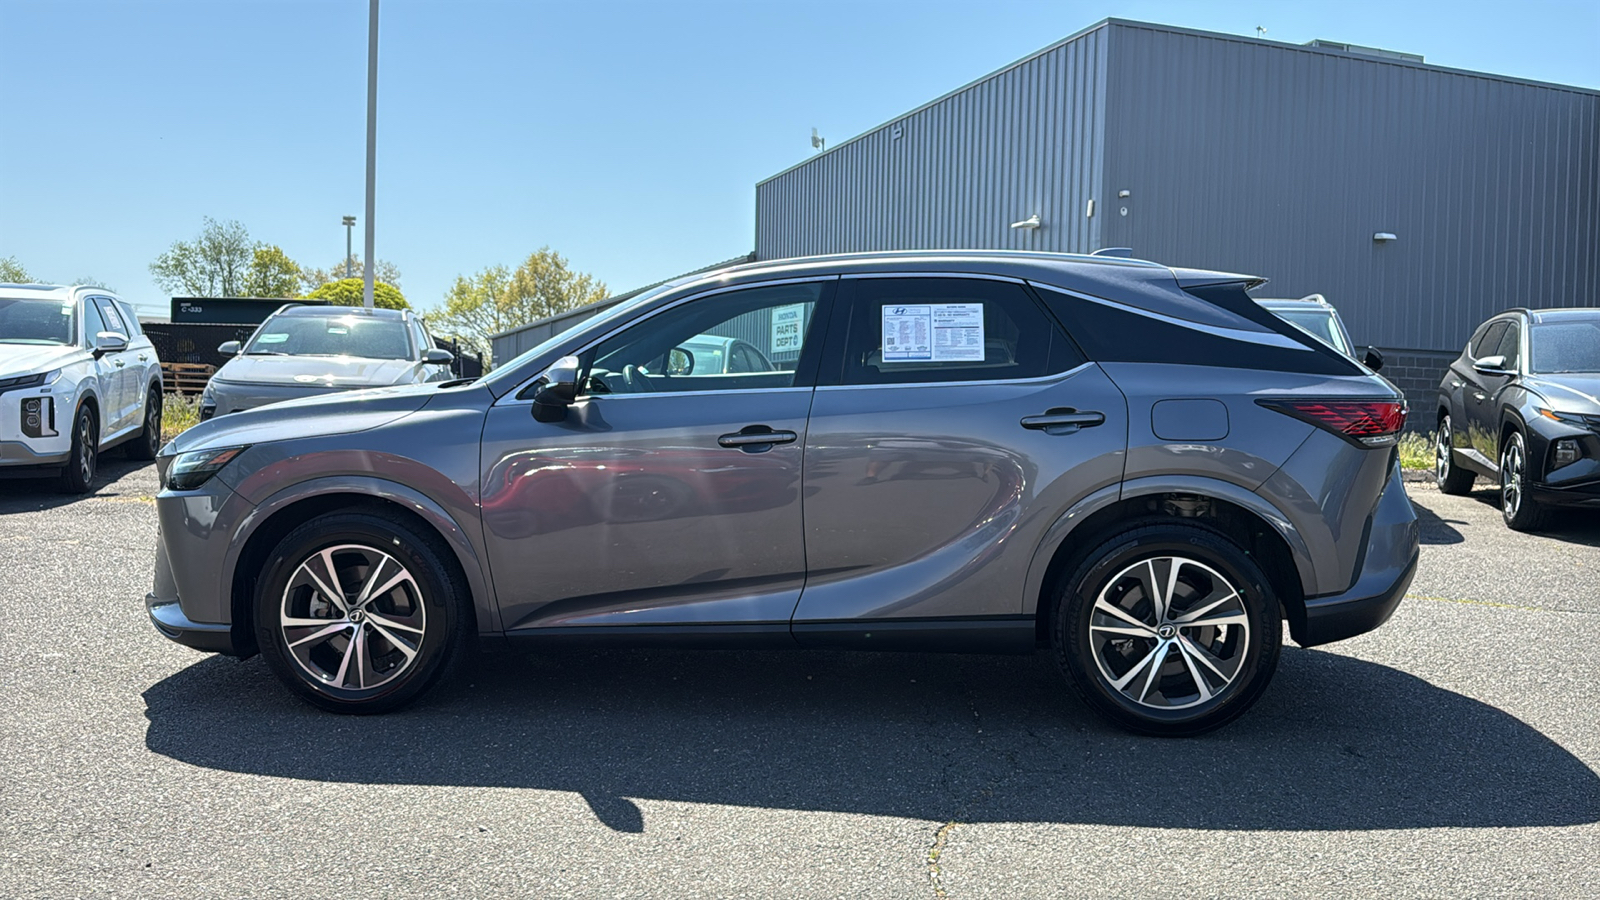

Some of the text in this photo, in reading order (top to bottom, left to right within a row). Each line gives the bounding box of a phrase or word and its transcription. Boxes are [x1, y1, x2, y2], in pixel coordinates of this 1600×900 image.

[777, 311, 798, 321] HONDA
[776, 323, 798, 335] PARTS
[776, 336, 793, 347] DEPT
